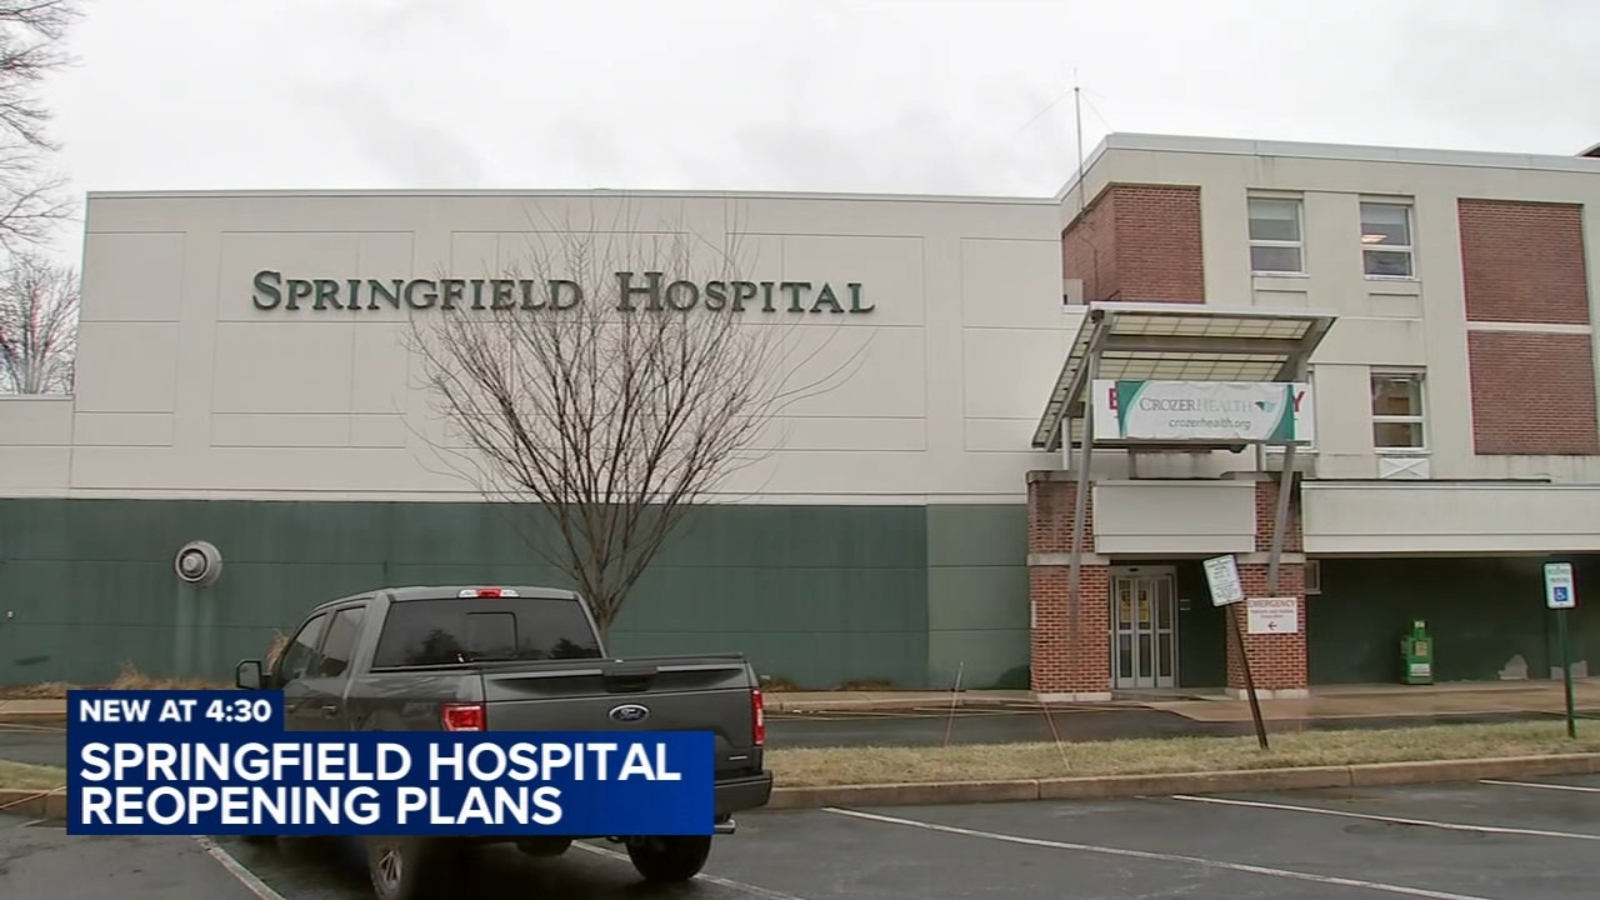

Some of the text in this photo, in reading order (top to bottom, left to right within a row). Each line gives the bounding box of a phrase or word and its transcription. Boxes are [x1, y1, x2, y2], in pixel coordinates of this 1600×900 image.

[252, 270, 875, 314] SPRINGFIELD HOSPITAL
[1168, 417, 1252, 430] crozerhealth.org
